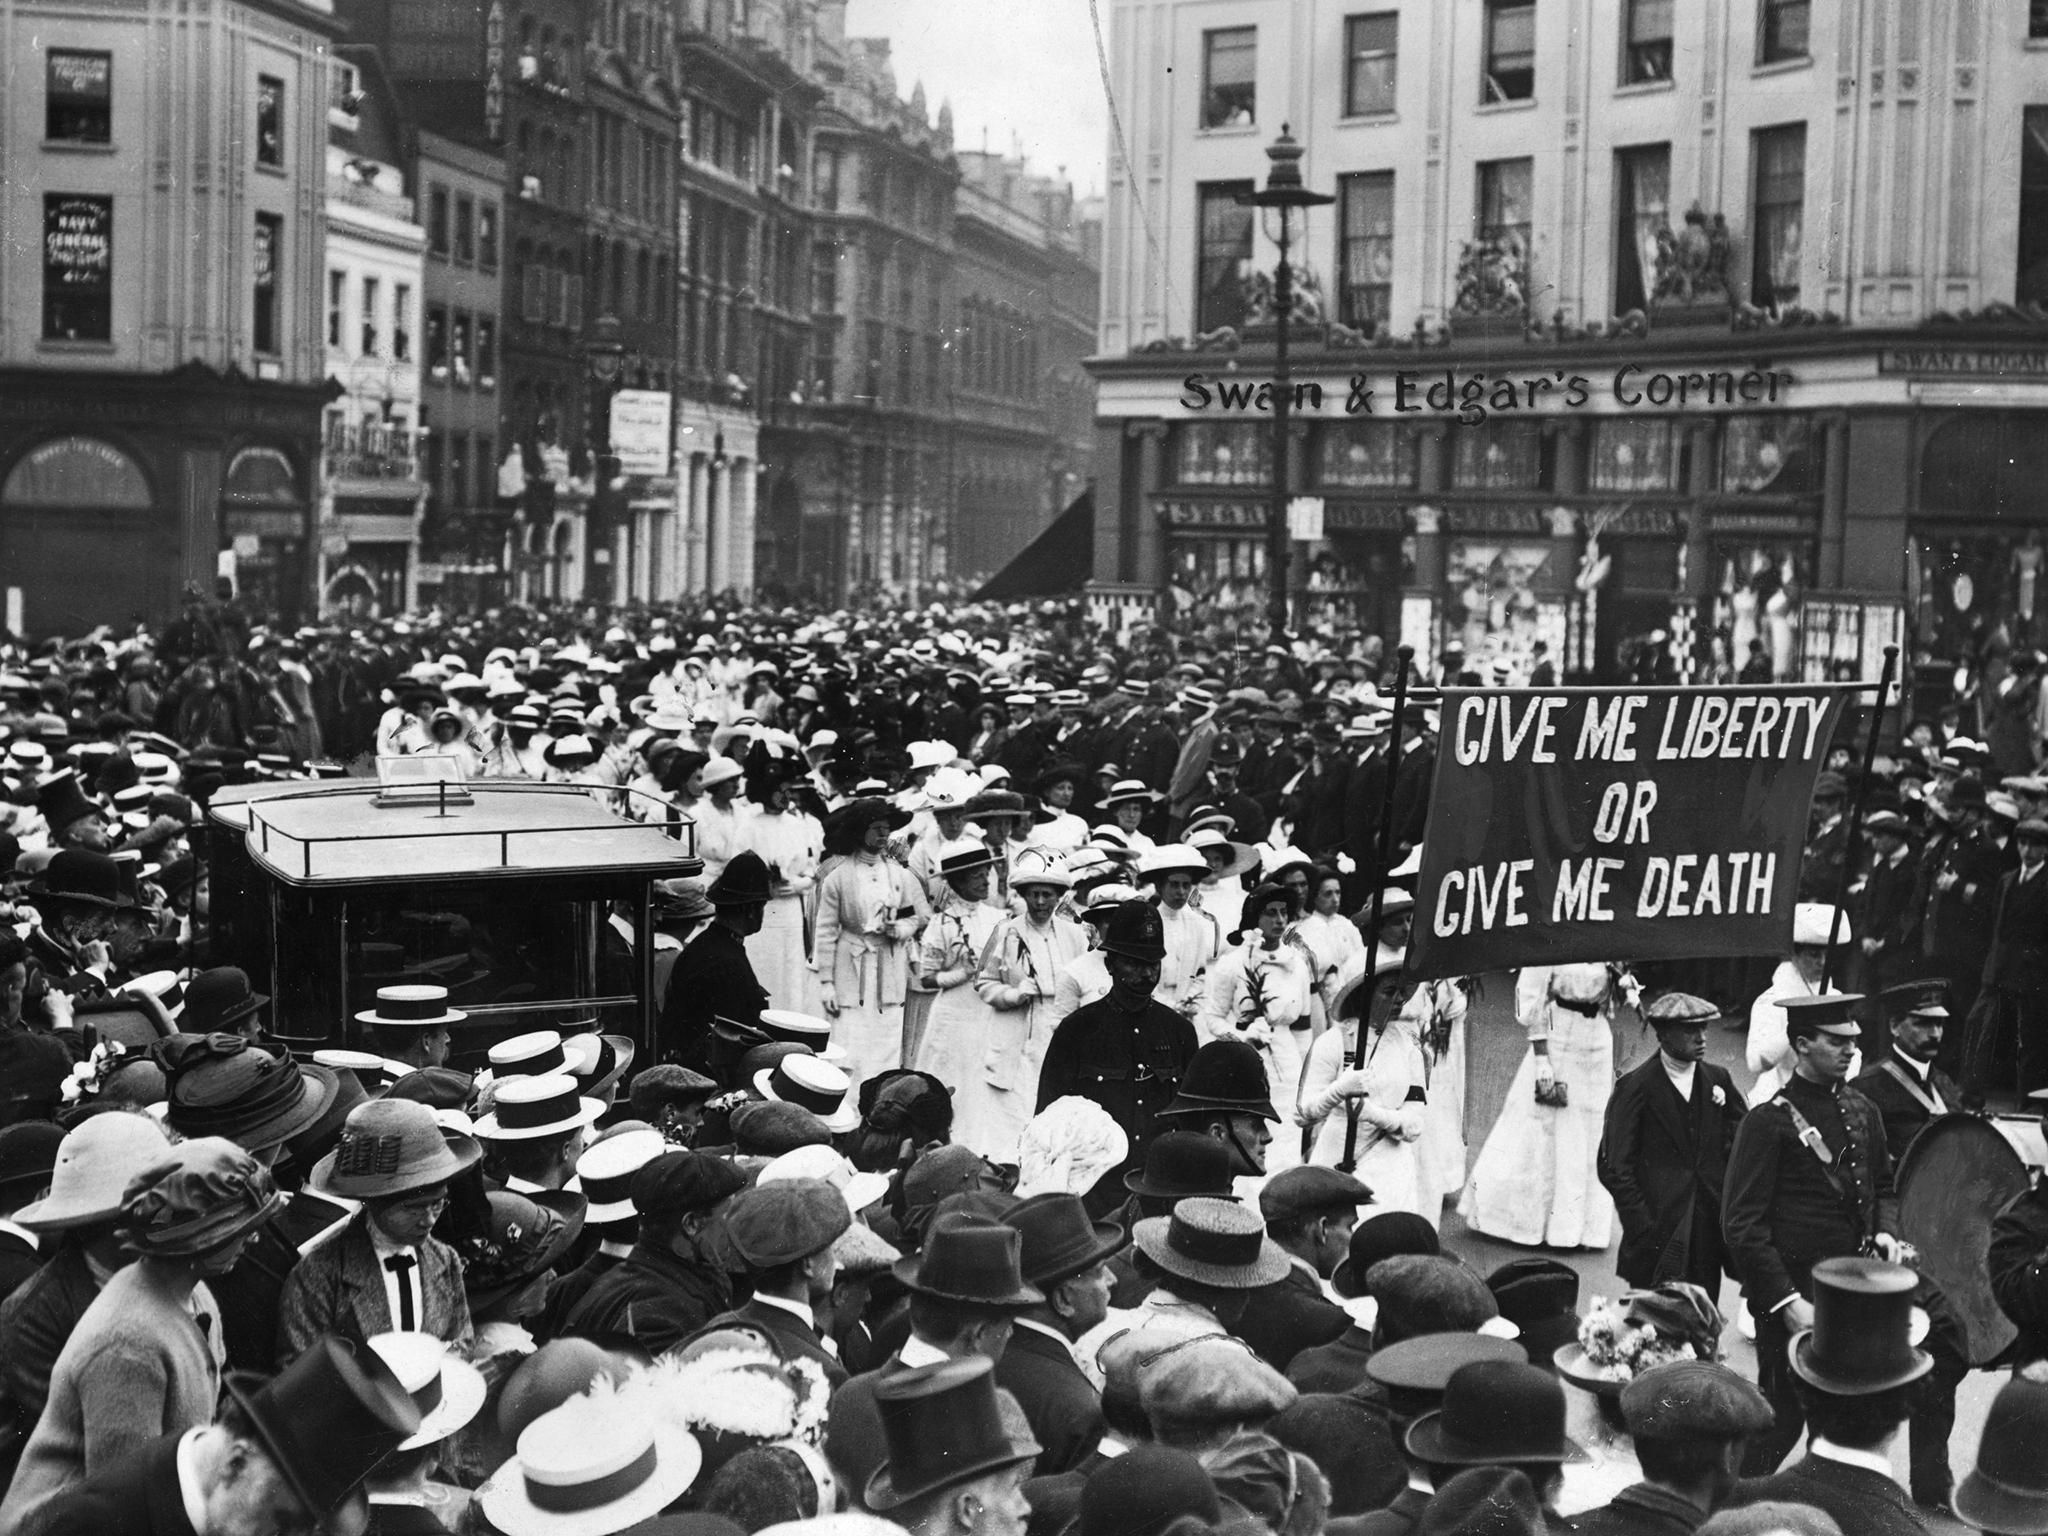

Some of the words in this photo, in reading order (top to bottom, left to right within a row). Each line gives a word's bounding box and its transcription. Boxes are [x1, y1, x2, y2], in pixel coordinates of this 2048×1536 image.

[1179, 371, 1323, 412] Swan
[1345, 371, 1375, 414] &
[1394, 369, 1590, 426] Edgar's
[1613, 363, 1794, 407] Corner
[1455, 695, 1568, 766] GIVE
[1574, 695, 1648, 762] ME
[1656, 695, 1830, 762] LIBERTY
[1593, 780, 1658, 845] OR
[1433, 858, 1535, 938] GIVE
[1552, 857, 1625, 923] ME
[1636, 851, 1776, 919] DEATH
